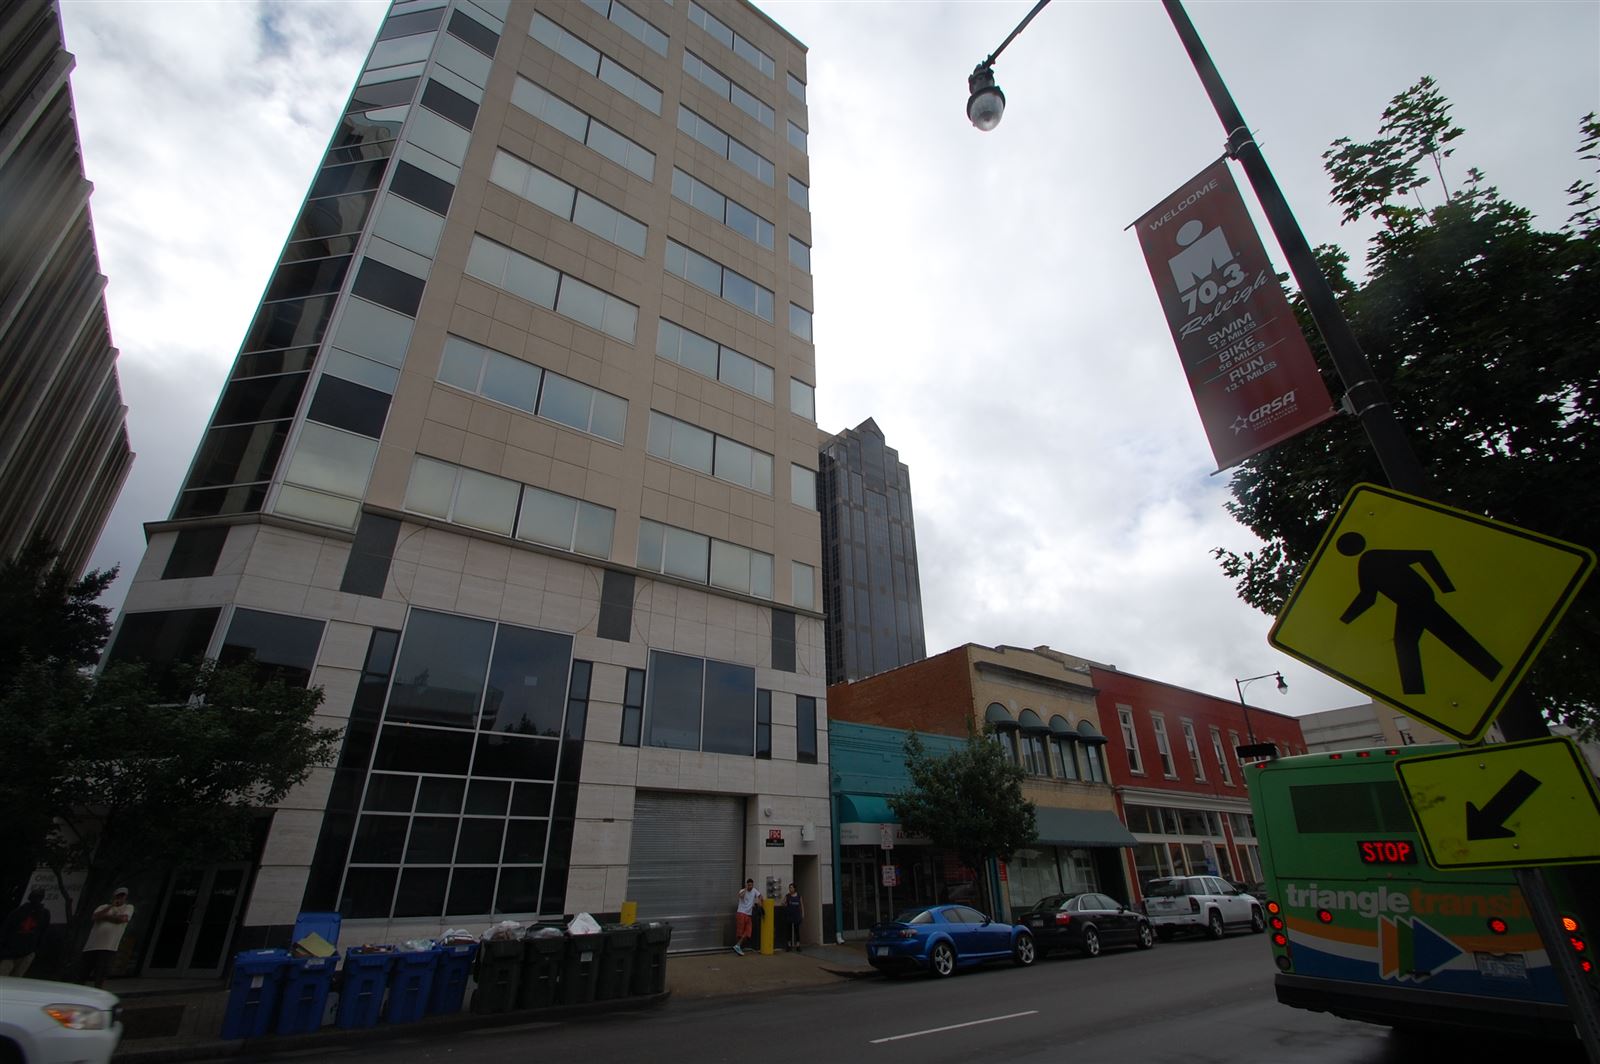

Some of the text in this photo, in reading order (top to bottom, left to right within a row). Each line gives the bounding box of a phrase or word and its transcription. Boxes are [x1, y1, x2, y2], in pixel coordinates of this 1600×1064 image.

[1149, 179, 1219, 230] WELCOME
[1179, 269, 1270, 340] Raleigh
[1181, 263, 1246, 315] 70.3
[1207, 311, 1252, 345] SWIM
[1212, 321, 1257, 350] 1.2 MILES
[1218, 335, 1256, 363] BIKE
[1218, 341, 1266, 372] 56 MILES
[1225, 361, 1278, 393] 13.1 MILES
[1229, 356, 1265, 382] RUN
[1249, 390, 1296, 422] GRSA
[1363, 842, 1411, 863] STOP
[1286, 883, 1411, 918] triangle
